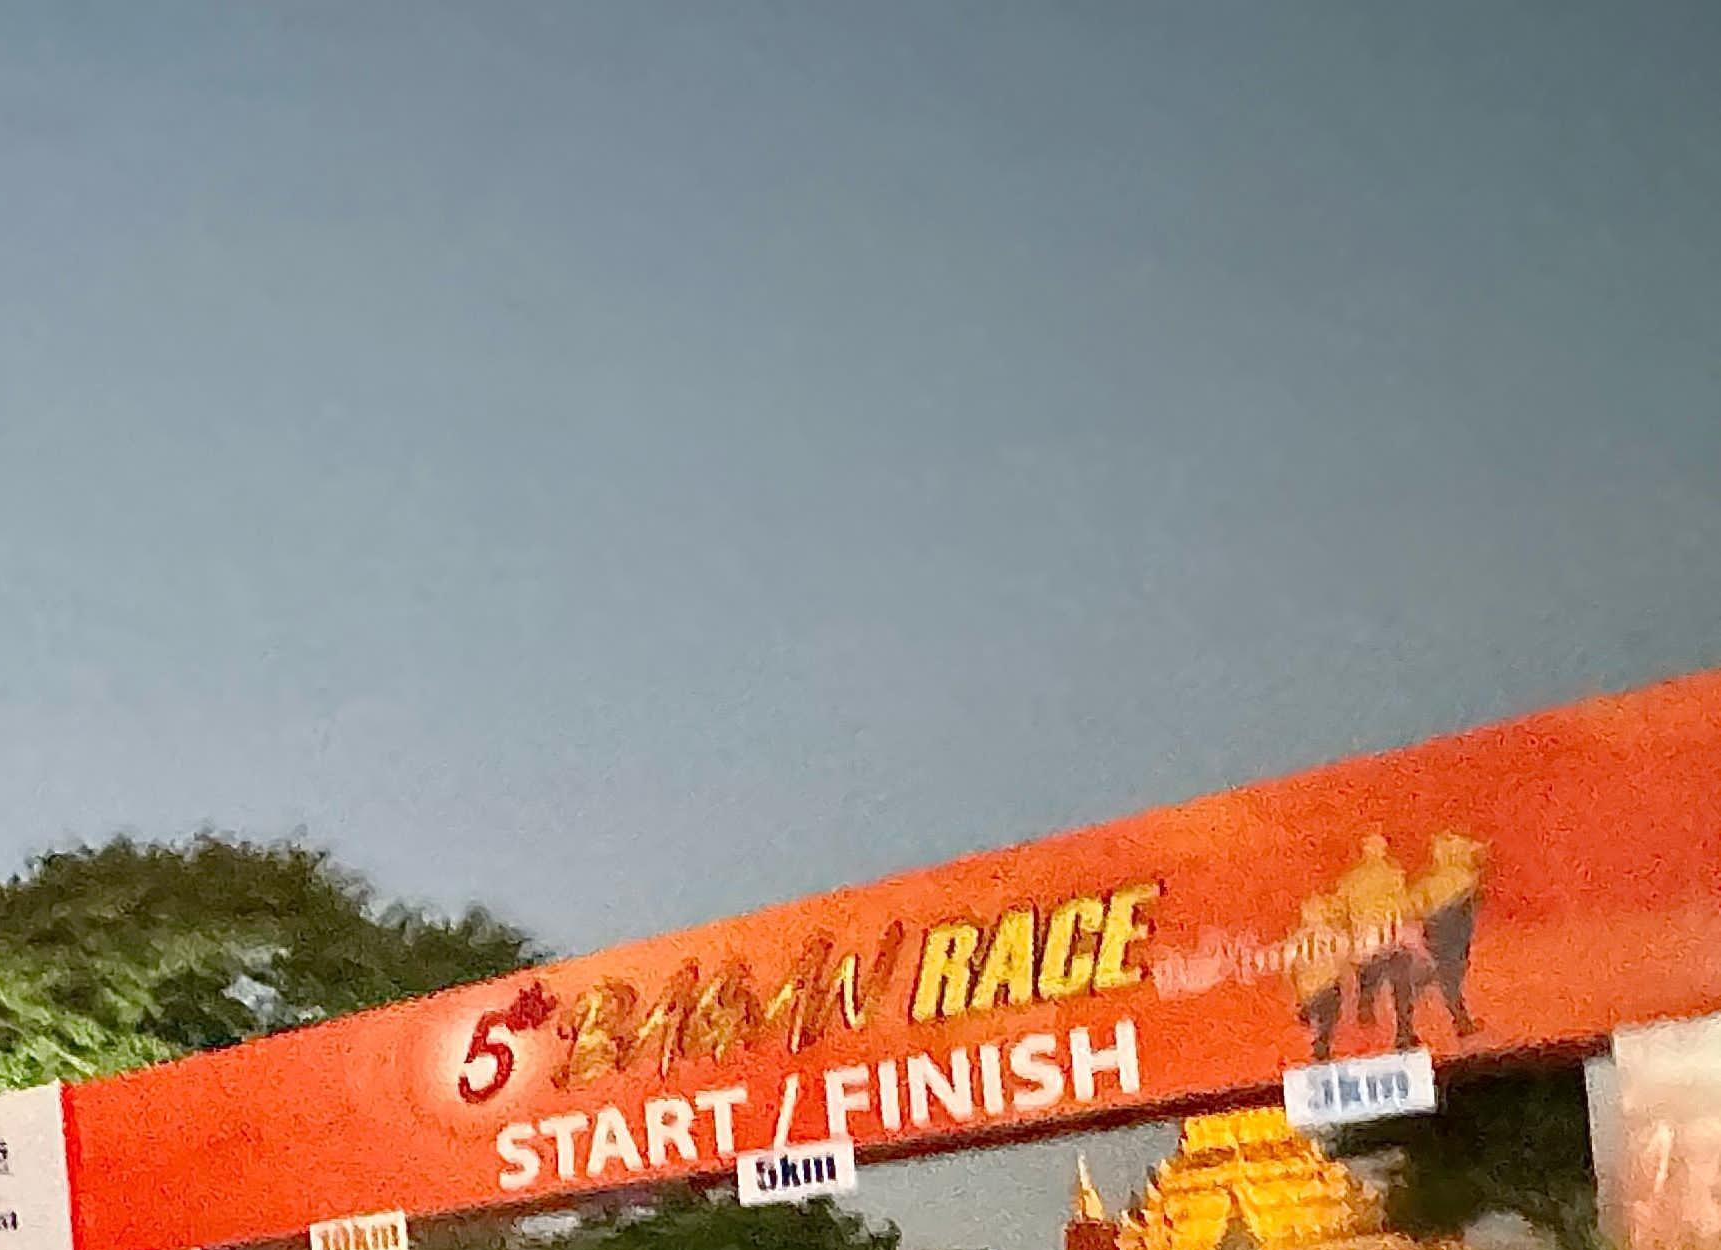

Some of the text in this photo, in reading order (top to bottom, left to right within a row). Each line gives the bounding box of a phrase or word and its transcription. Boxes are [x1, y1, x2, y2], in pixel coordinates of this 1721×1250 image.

[908, 880, 1166, 1023] RACE
[496, 1086, 747, 1192] START
[824, 1017, 1140, 1140] FINISH
